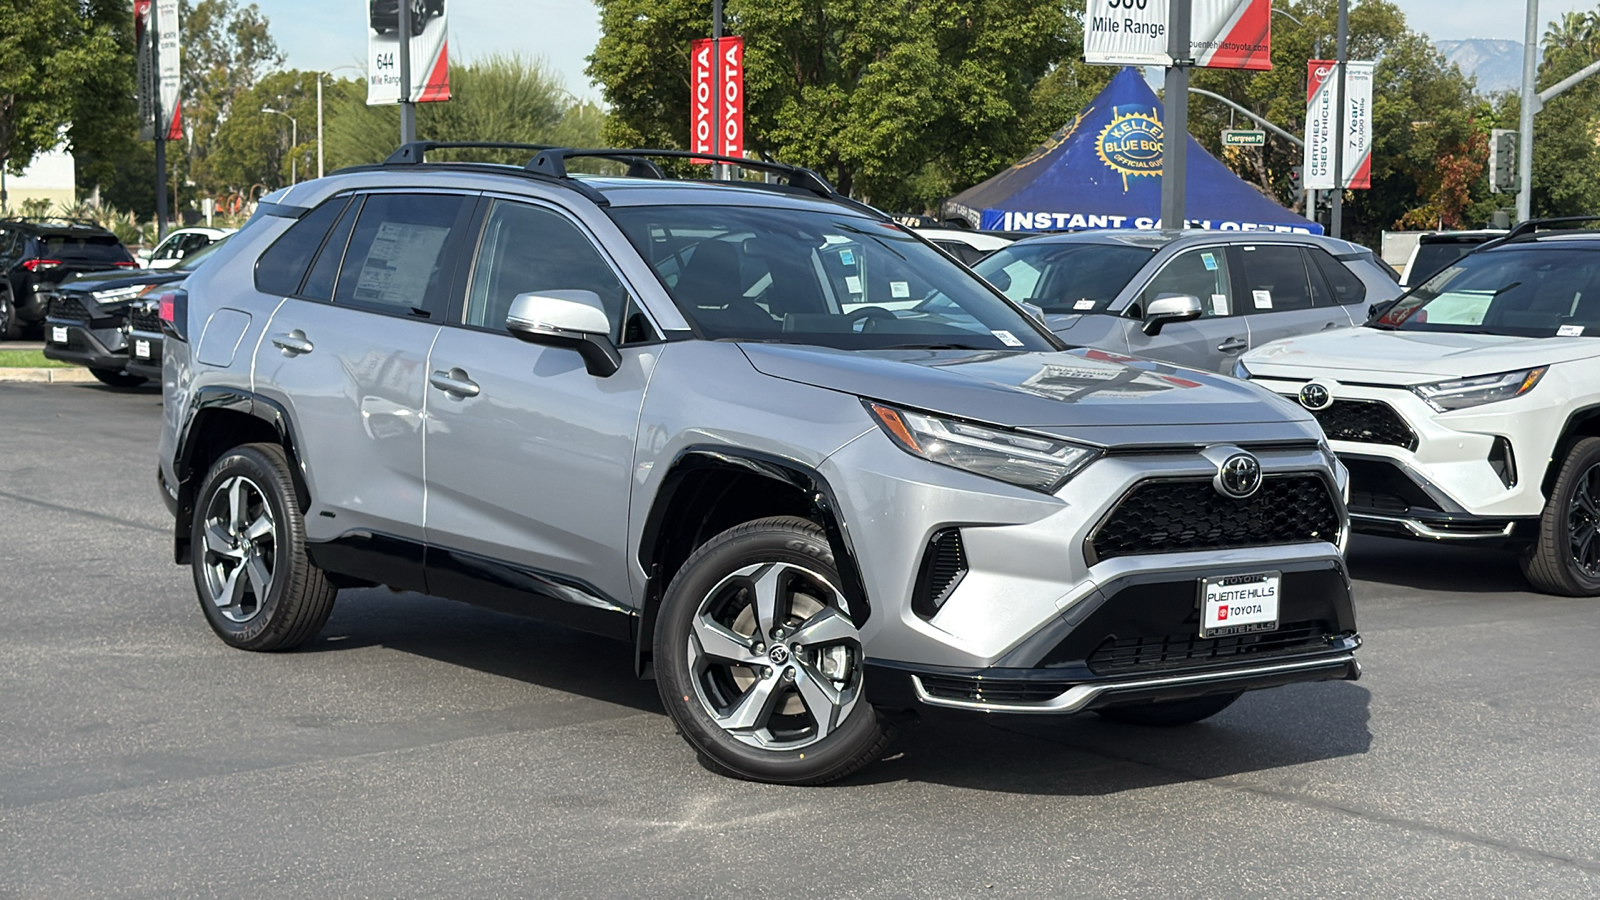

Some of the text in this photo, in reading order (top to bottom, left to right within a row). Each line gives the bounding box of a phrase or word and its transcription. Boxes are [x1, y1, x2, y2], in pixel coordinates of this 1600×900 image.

[1092, 16, 1164, 38] Mile Range
[376, 52, 394, 70] 644
[697, 47, 709, 154] TOYOTA
[725, 45, 738, 157] TOYOTA
[1320, 90, 1329, 176] USED VEHICLES
[1350, 98, 1358, 149] 7 Year/
[1105, 140, 1164, 153] BLUE BOO
[1311, 119, 1320, 177] CERTIFIED
[1114, 153, 1149, 167] OFFICIAL
[1004, 211, 1128, 232] INSTANT
[1224, 574, 1262, 584] TOYOTA
[1207, 586, 1275, 603] PUENTE HILLS
[1230, 604, 1262, 617] TOYOTA
[1206, 621, 1275, 637] PUENTE HILLS
